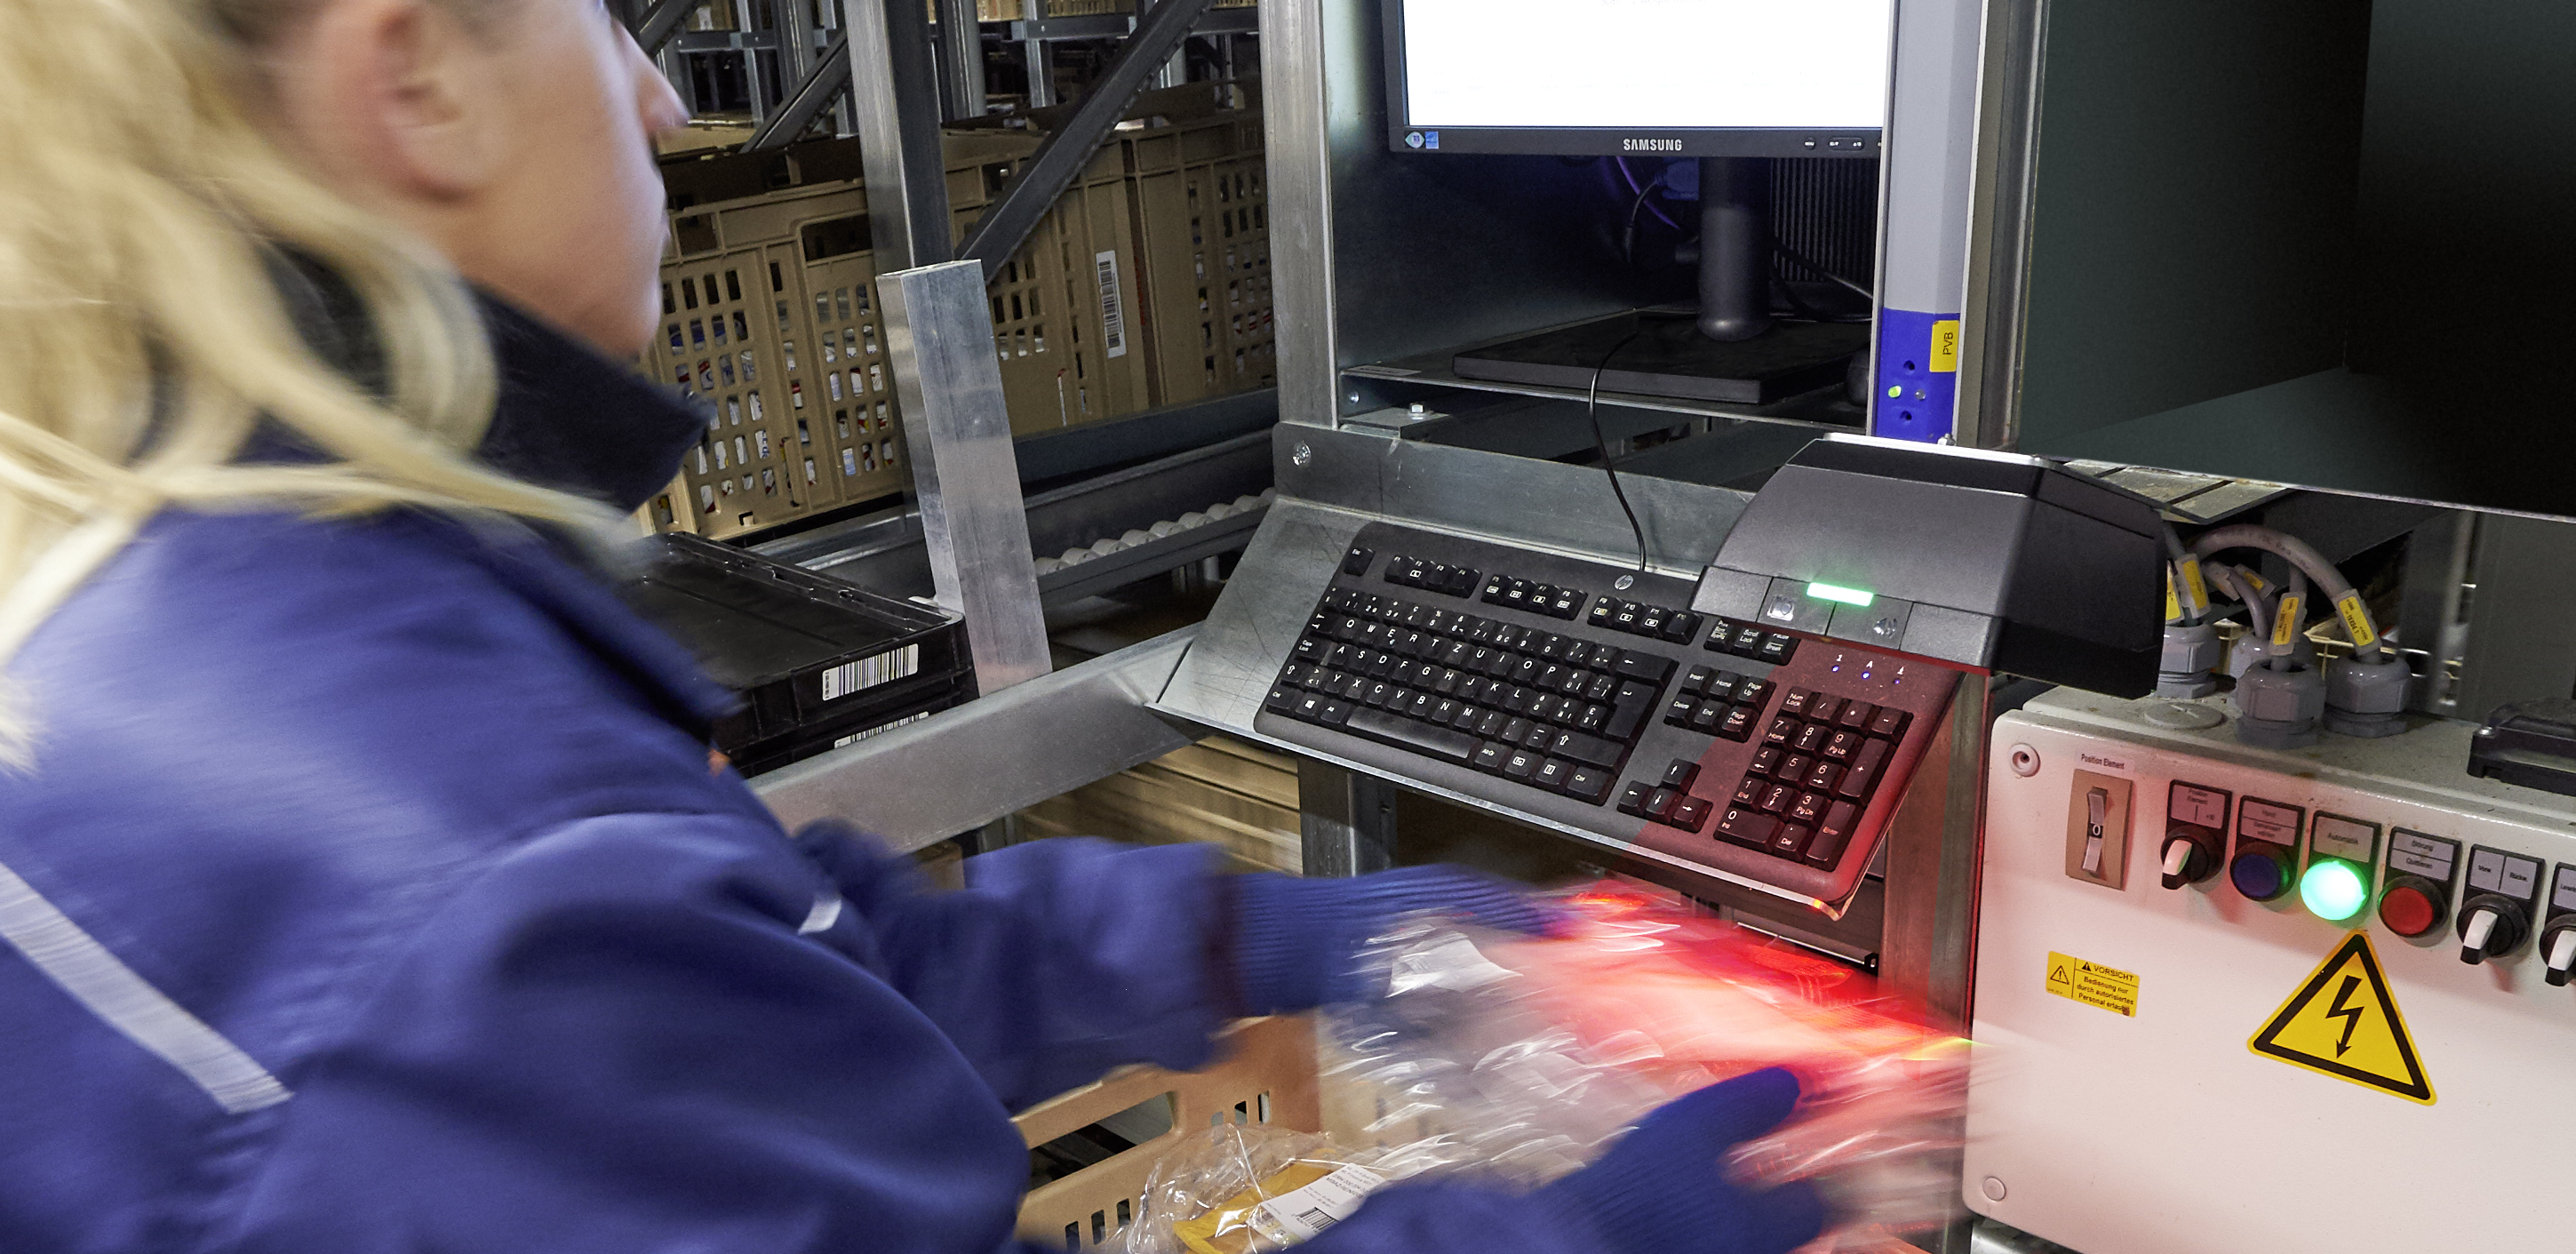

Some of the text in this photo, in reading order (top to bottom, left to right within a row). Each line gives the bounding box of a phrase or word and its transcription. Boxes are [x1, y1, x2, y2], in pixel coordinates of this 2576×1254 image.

[1623, 139, 1682, 151] SAMSUNG
[1942, 332, 1953, 355] PVB
[1422, 667, 1431, 675] G
[1352, 679, 1361, 688] X
[1490, 683, 1499, 691] K
[1375, 684, 1383, 693] C
[1397, 690, 1404, 699] V
[1514, 689, 1520, 698] L
[1417, 696, 1426, 705] B
[1775, 720, 1784, 729] 7
[1806, 727, 1814, 736] 8
[1835, 734, 1844, 743] 9
[1789, 758, 1798, 767] 5
[2081, 754, 2125, 770] Position Element
[1818, 764, 1827, 774] 6
[1773, 787, 1782, 797] 2
[1802, 795, 1812, 804] 3
[1727, 811, 1737, 820] 0
[2093, 825, 2101, 835] 0
[2327, 833, 2359, 845] Automatik
[2093, 965, 2134, 981] VORSICHT
[2084, 976, 2117, 992] Bedienung
[2079, 992, 2105, 1005] Personal
